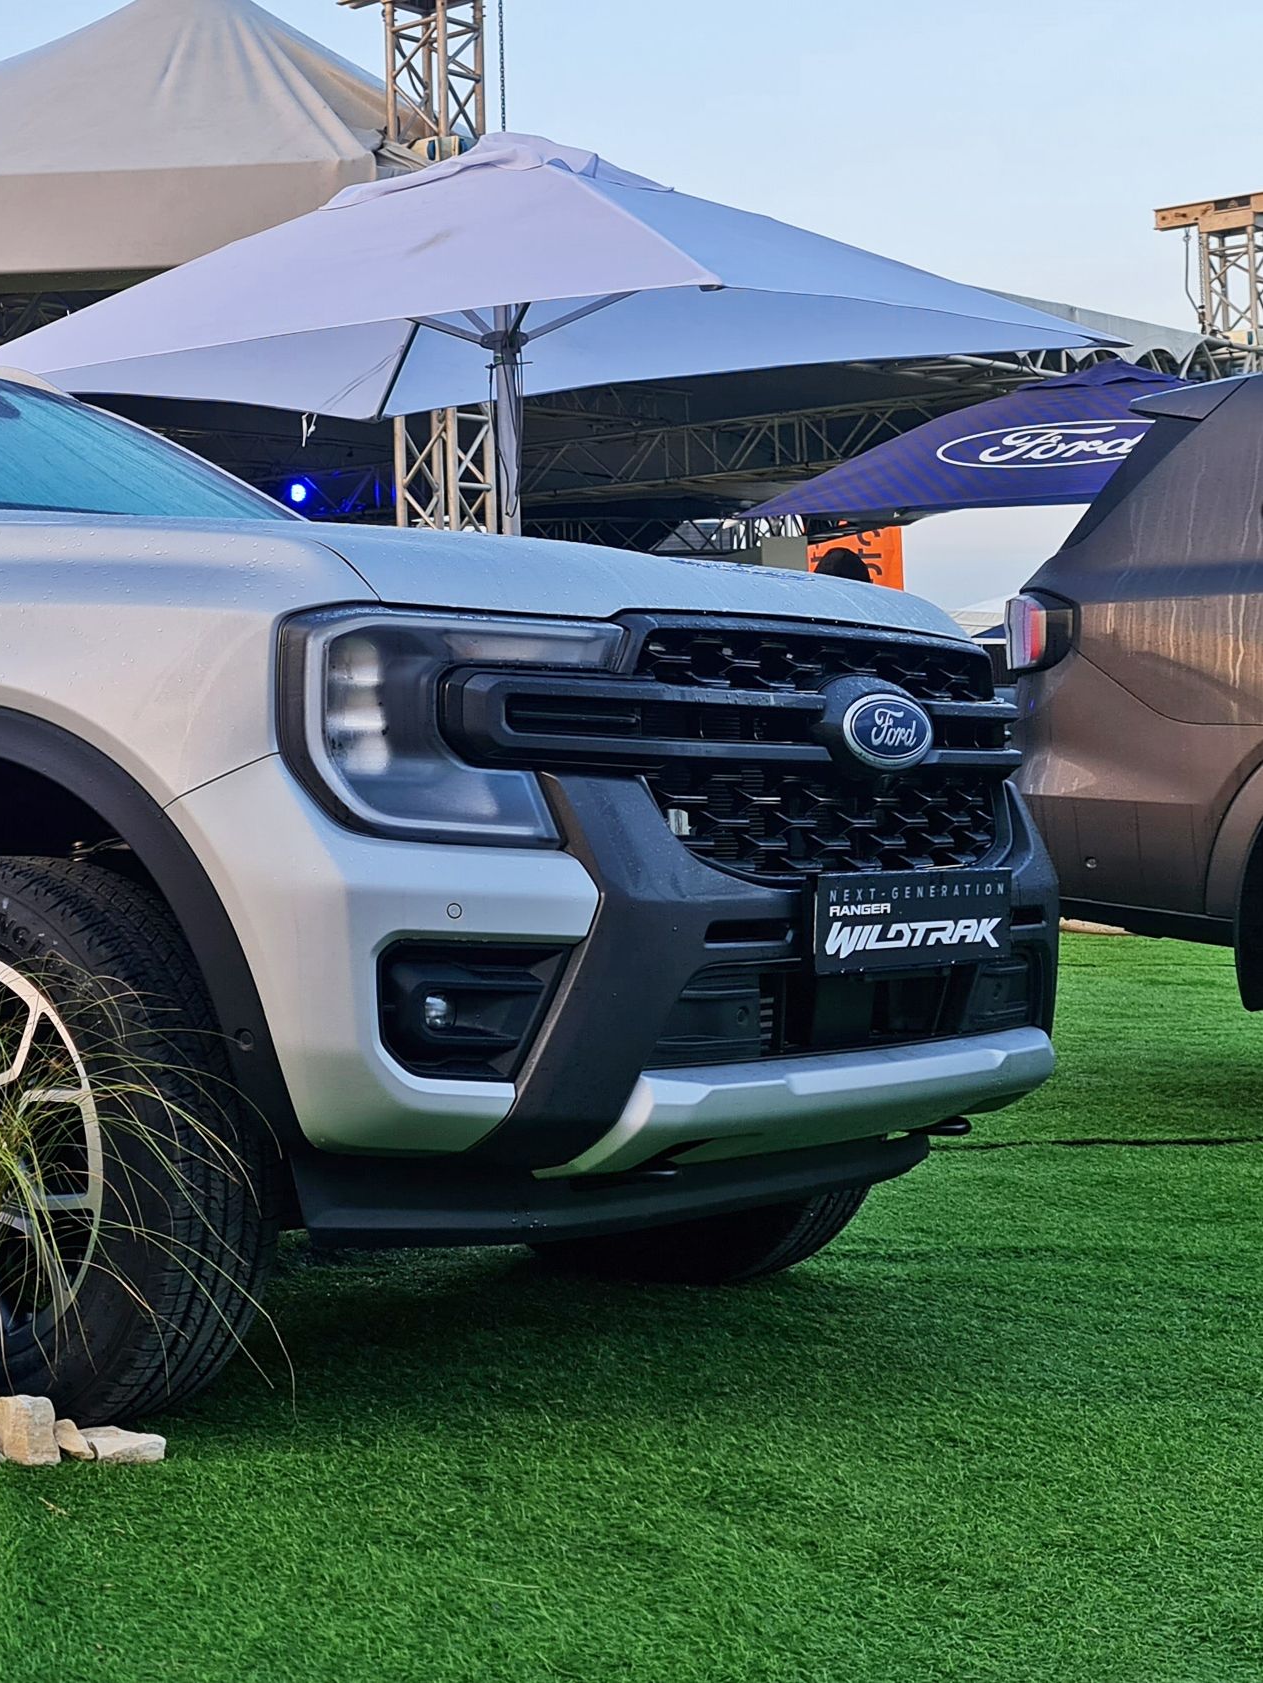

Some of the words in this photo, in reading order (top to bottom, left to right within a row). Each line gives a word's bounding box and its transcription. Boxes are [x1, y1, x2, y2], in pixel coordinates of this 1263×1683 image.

[978, 425, 1146, 463] Ford
[871, 708, 917, 747] Ford
[829, 883, 1005, 903] NEXT-GENERATION
[829, 903, 891, 917] RANGER
[824, 917, 1003, 959] WILDTRAK
